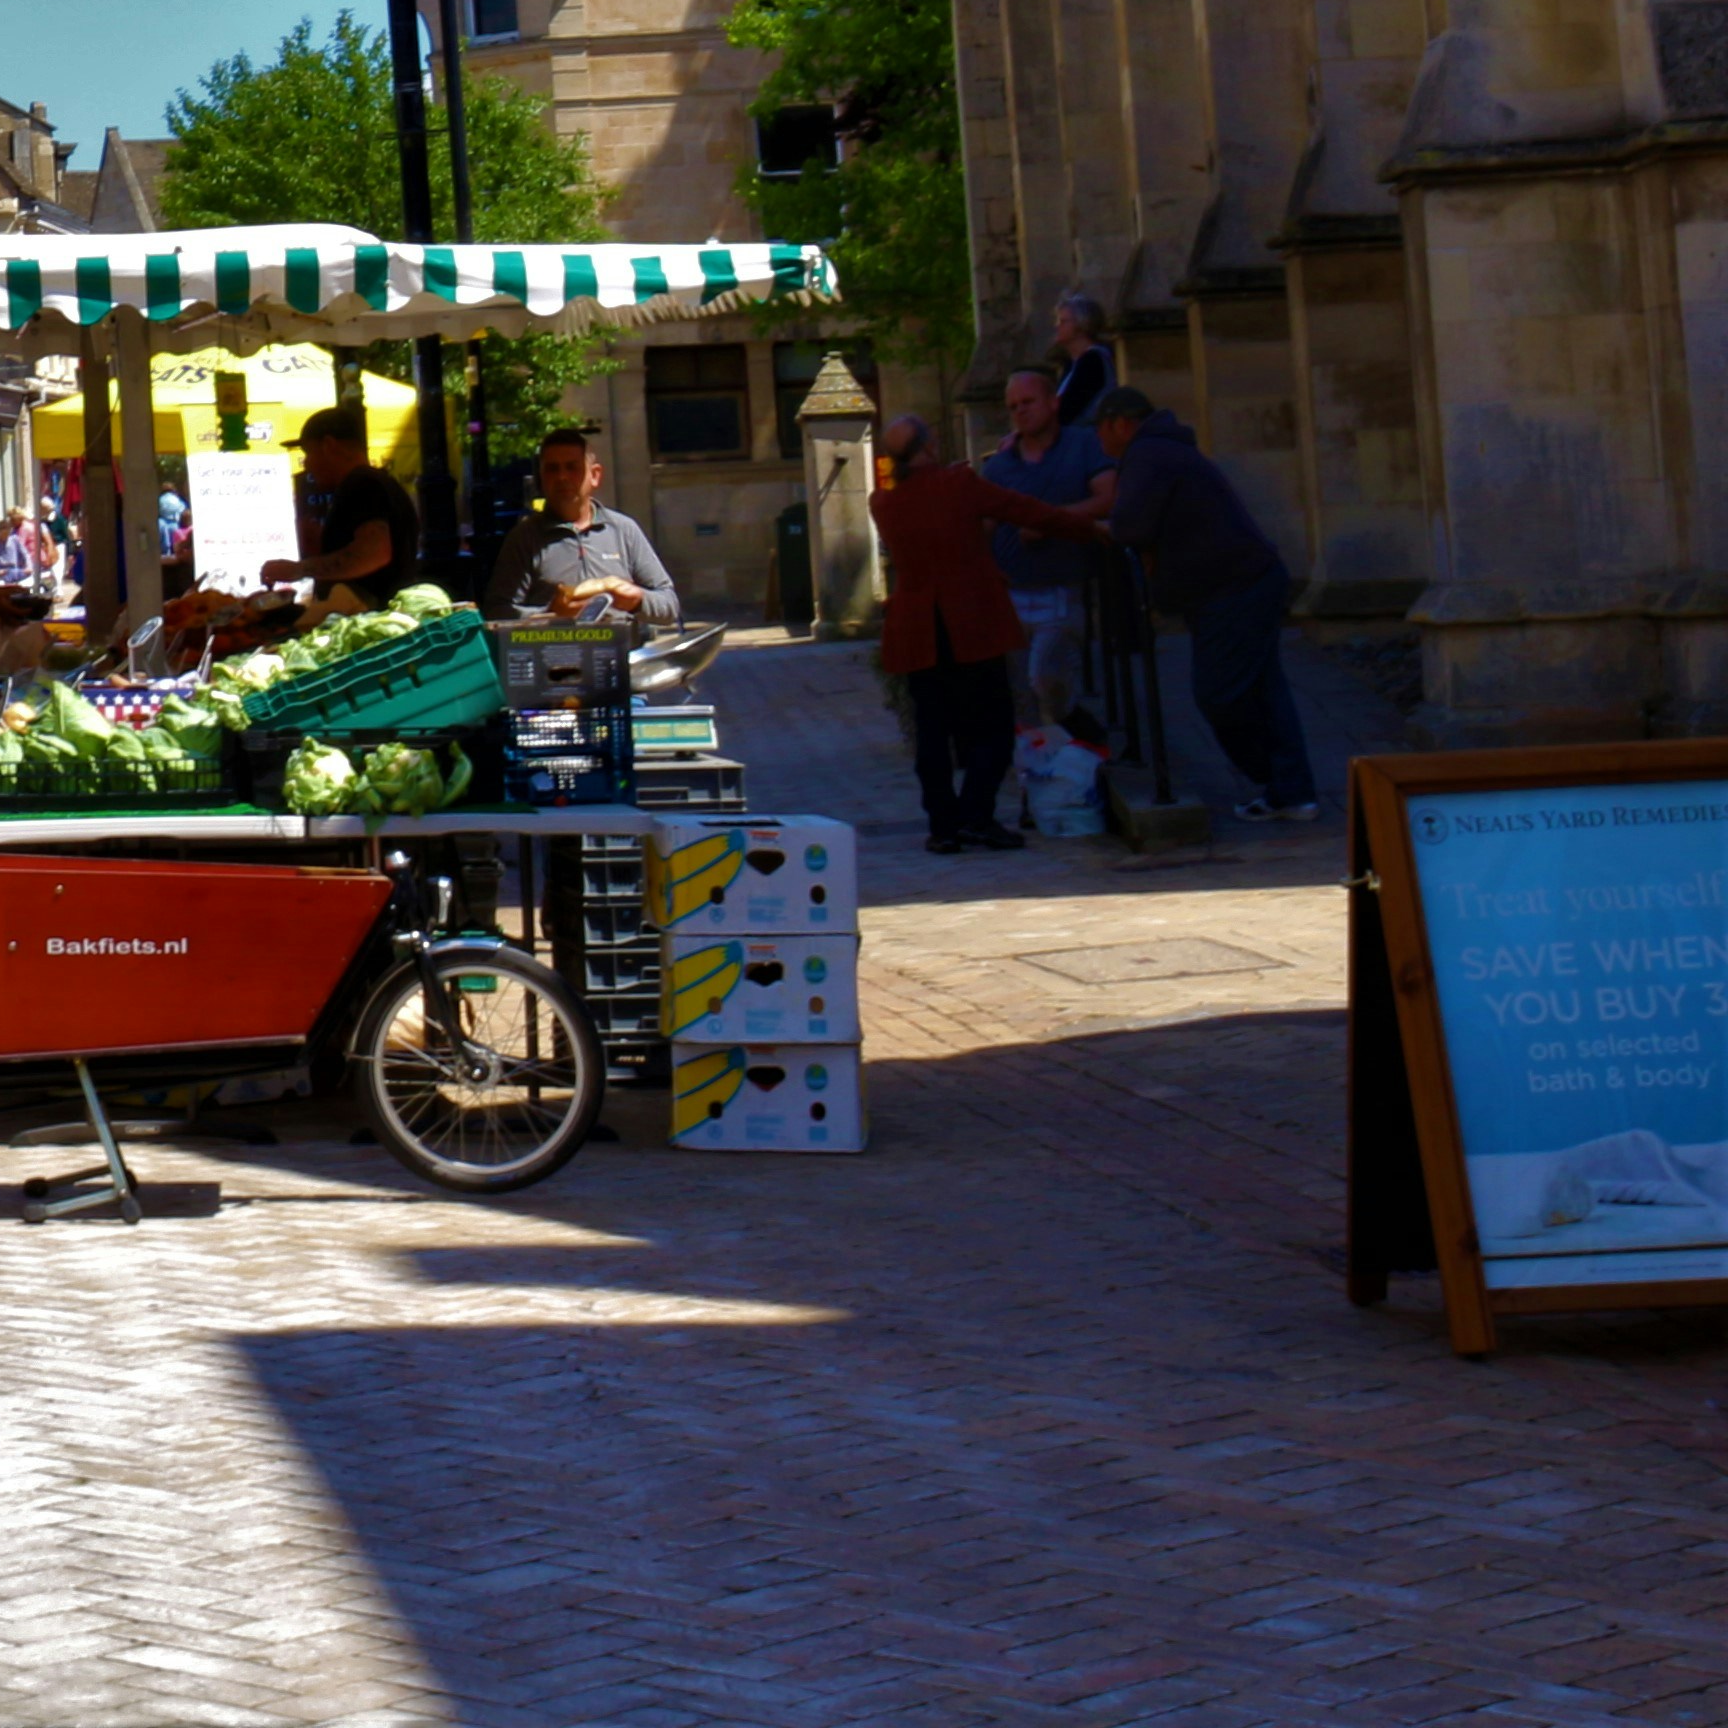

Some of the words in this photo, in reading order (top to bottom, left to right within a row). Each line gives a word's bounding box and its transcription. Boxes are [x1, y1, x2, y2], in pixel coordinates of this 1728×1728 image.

[151, 365, 213, 383] ATS
[511, 629, 573, 643] PREMIUM
[575, 628, 615, 642] GOLD
[1455, 814, 1535, 835] NEAL'S
[1539, 808, 1605, 830] YARD
[1441, 881, 1552, 921] Treat
[1563, 869, 1728, 922] yourself
[45, 937, 188, 955] Bakfiets.nl
[1459, 941, 1580, 981] SAVE
[1591, 934, 1728, 975] WHEN
[1483, 988, 1582, 1026] YOU
[1595, 982, 1687, 1022] BUY
[1700, 981, 1728, 1018] 3
[1527, 1038, 1568, 1061] on
[1575, 1028, 1700, 1059] selected
[1527, 1068, 1596, 1093] bath
[1605, 1066, 1625, 1088] &
